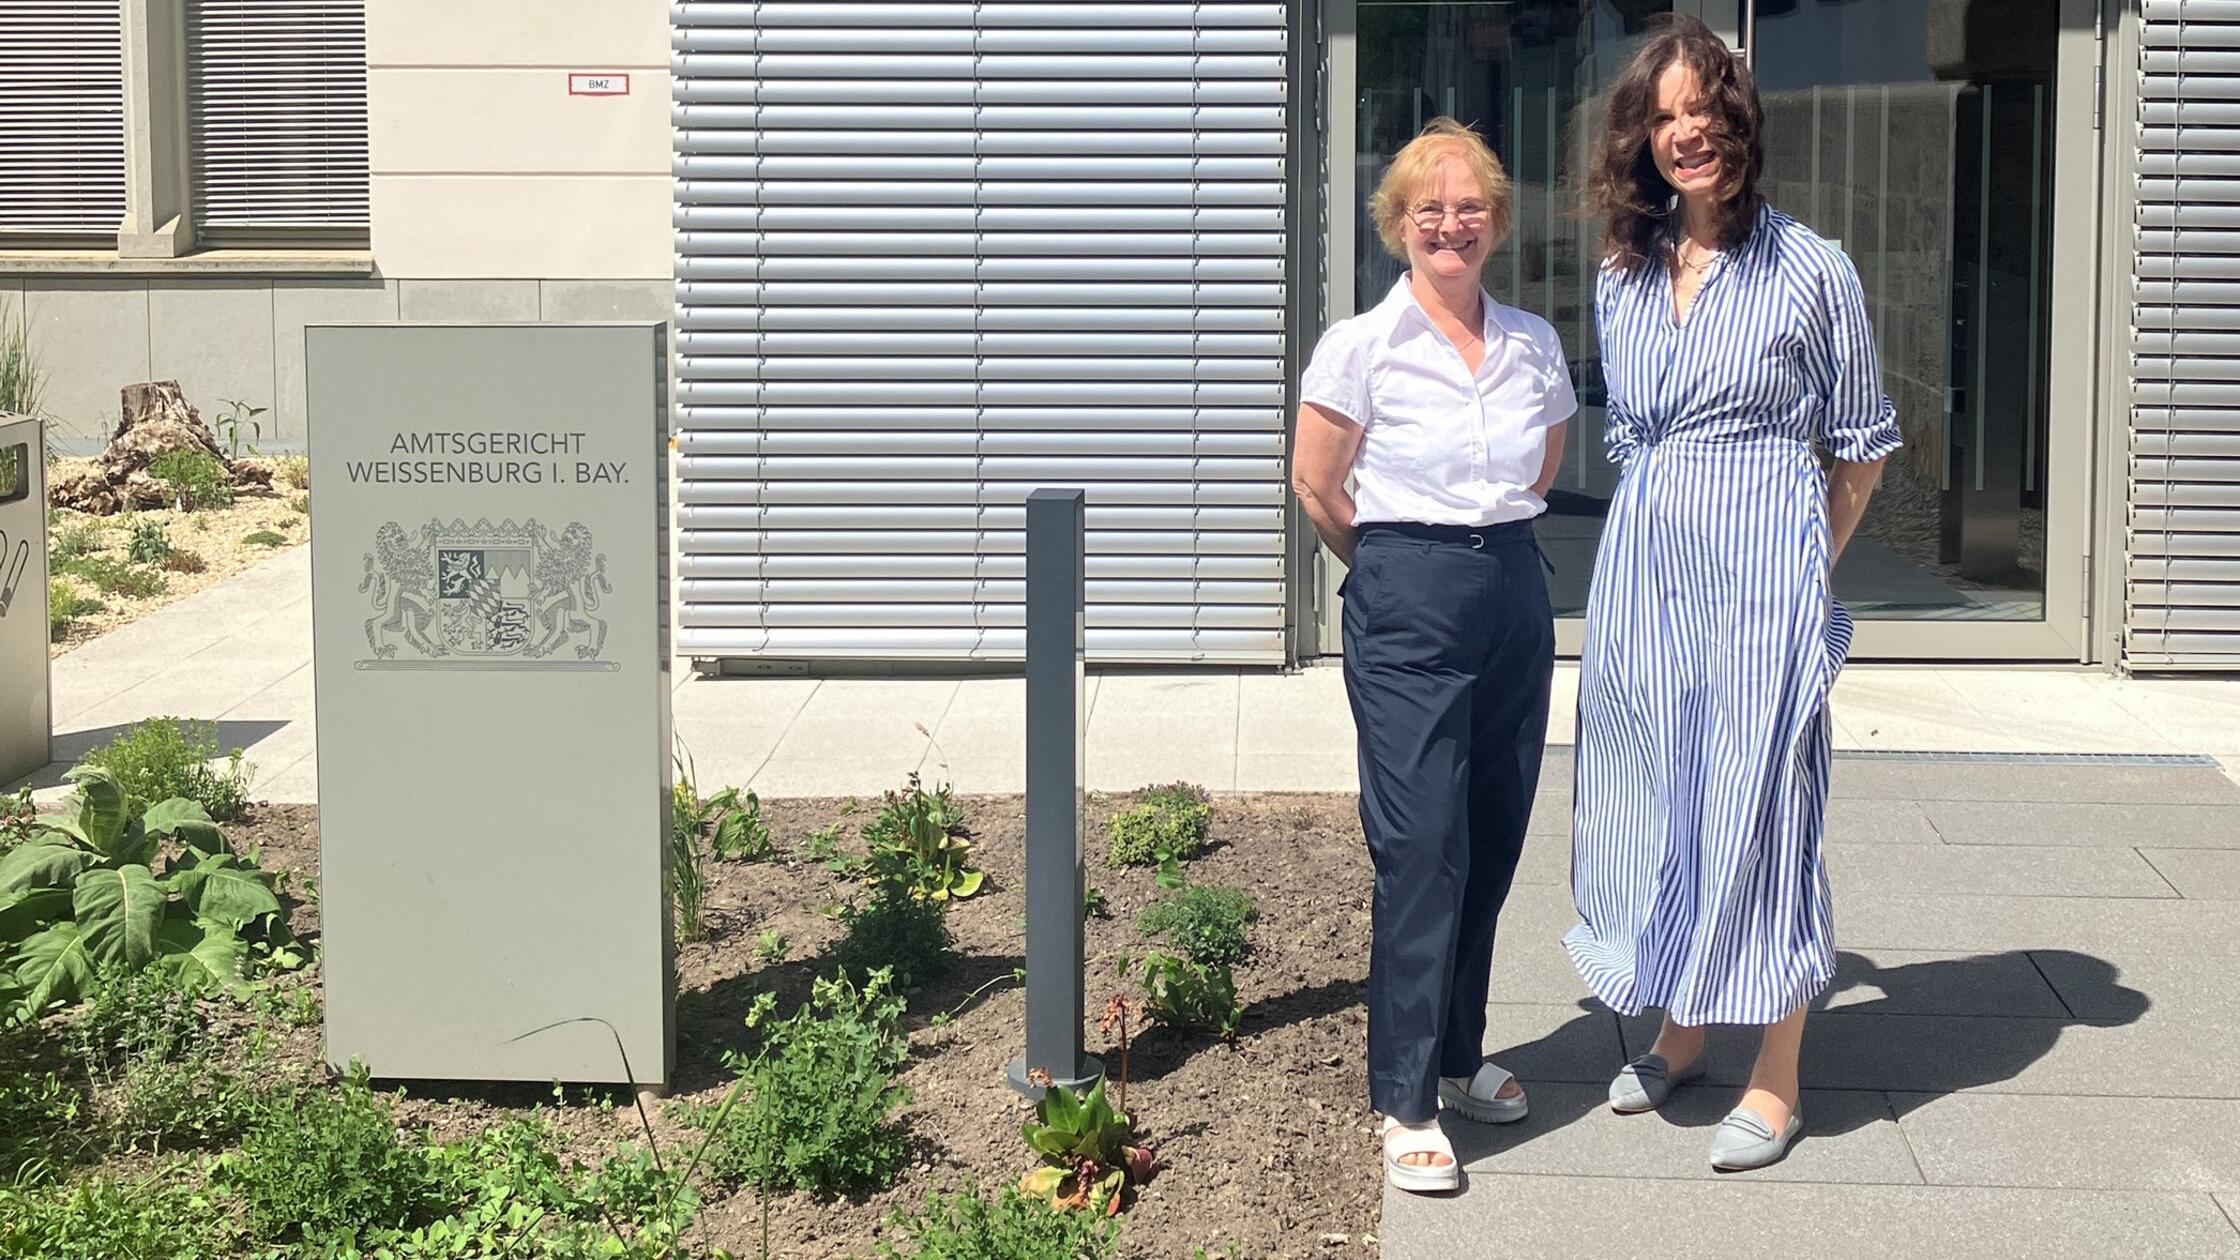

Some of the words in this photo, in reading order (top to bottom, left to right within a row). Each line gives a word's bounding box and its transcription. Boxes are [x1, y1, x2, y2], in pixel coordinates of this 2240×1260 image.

[588, 79, 610, 89] BMZ
[390, 432, 586, 455] AMTSGERICHT
[346, 461, 542, 484] WEISSENBURG
[552, 462, 565, 484] I.
[576, 462, 630, 484] BAY.
